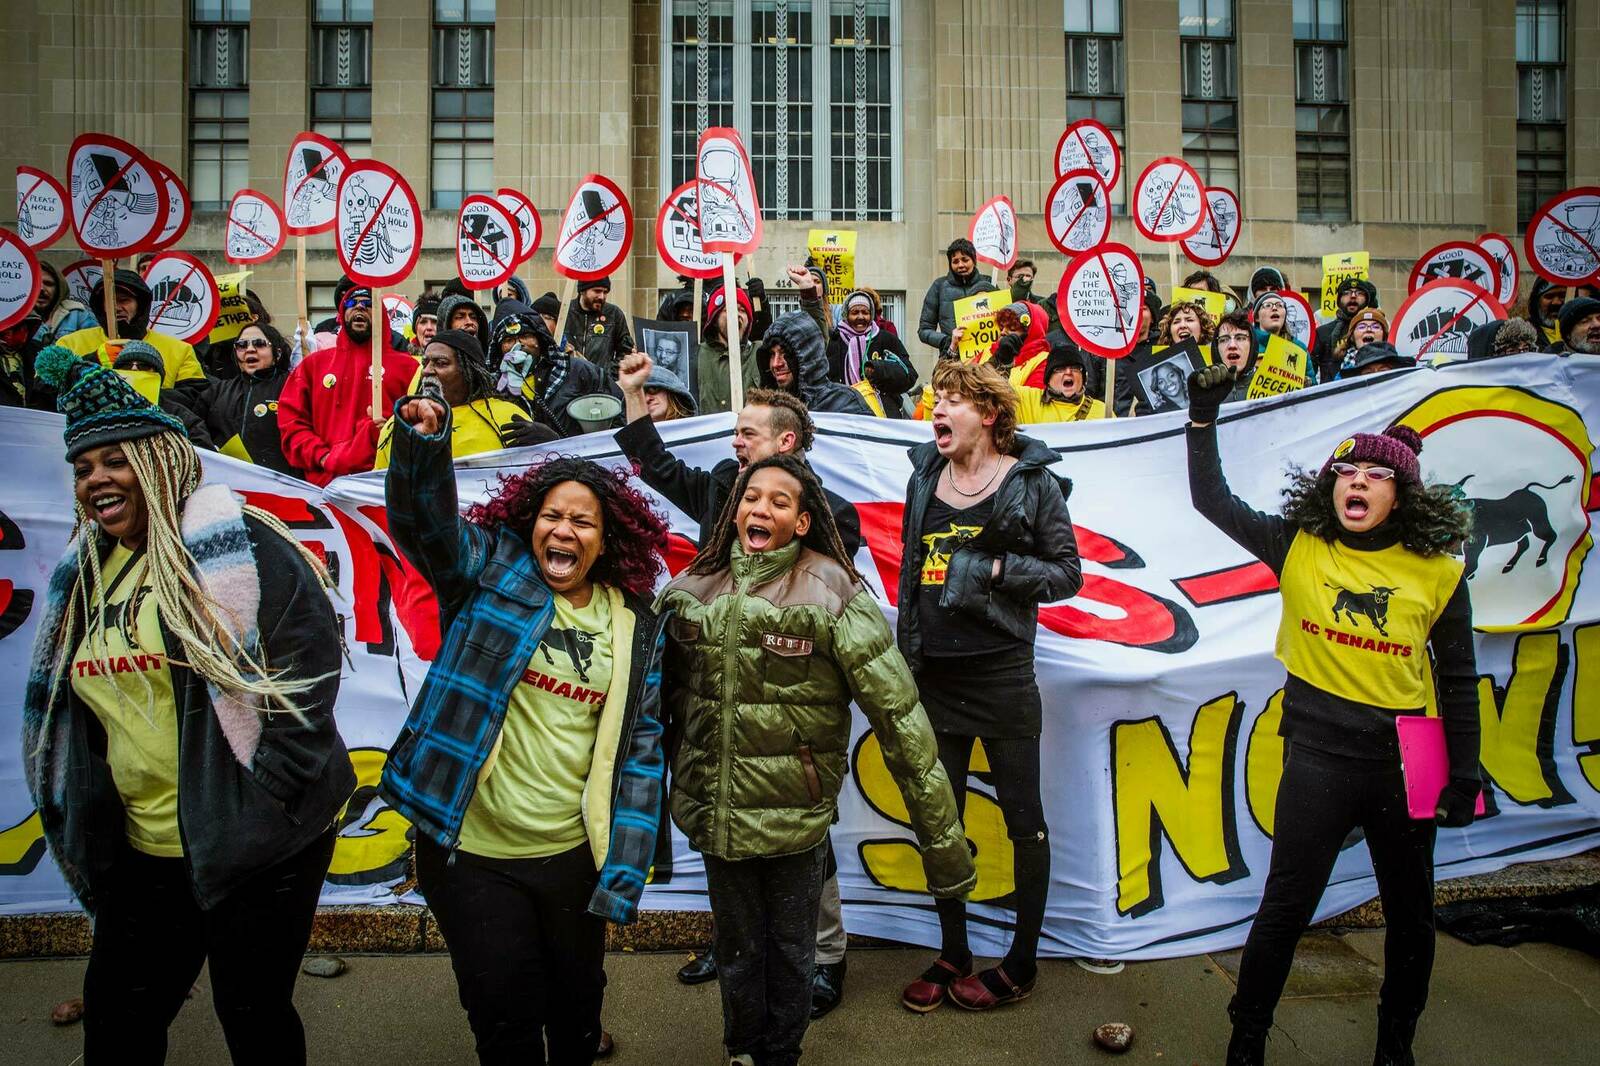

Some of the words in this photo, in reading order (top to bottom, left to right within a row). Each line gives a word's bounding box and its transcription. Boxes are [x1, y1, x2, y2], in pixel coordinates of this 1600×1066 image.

[30, 194, 57, 204] PLEASE
[31, 204, 55, 212] HOLD
[386, 203, 409, 217] PLEASE
[466, 205, 489, 213] GOOD
[388, 216, 408, 229] HOLD
[680, 254, 717, 266] ENOUGH
[822, 254, 841, 265] WE
[1438, 250, 1464, 261] GOOD
[0, 271, 22, 280] OLD
[1082, 269, 1100, 279] PIN
[775, 279, 792, 288] 414
[1081, 280, 1099, 289] THE
[1072, 289, 1112, 299] EVICTION
[1077, 299, 1091, 307] ON
[1093, 299, 1105, 307] THE
[1074, 308, 1111, 317] TENANT
[979, 320, 994, 330] DO
[970, 330, 999, 346] YOU
[1301, 619, 1320, 635] KC
[1324, 628, 1413, 657] TENANTS
